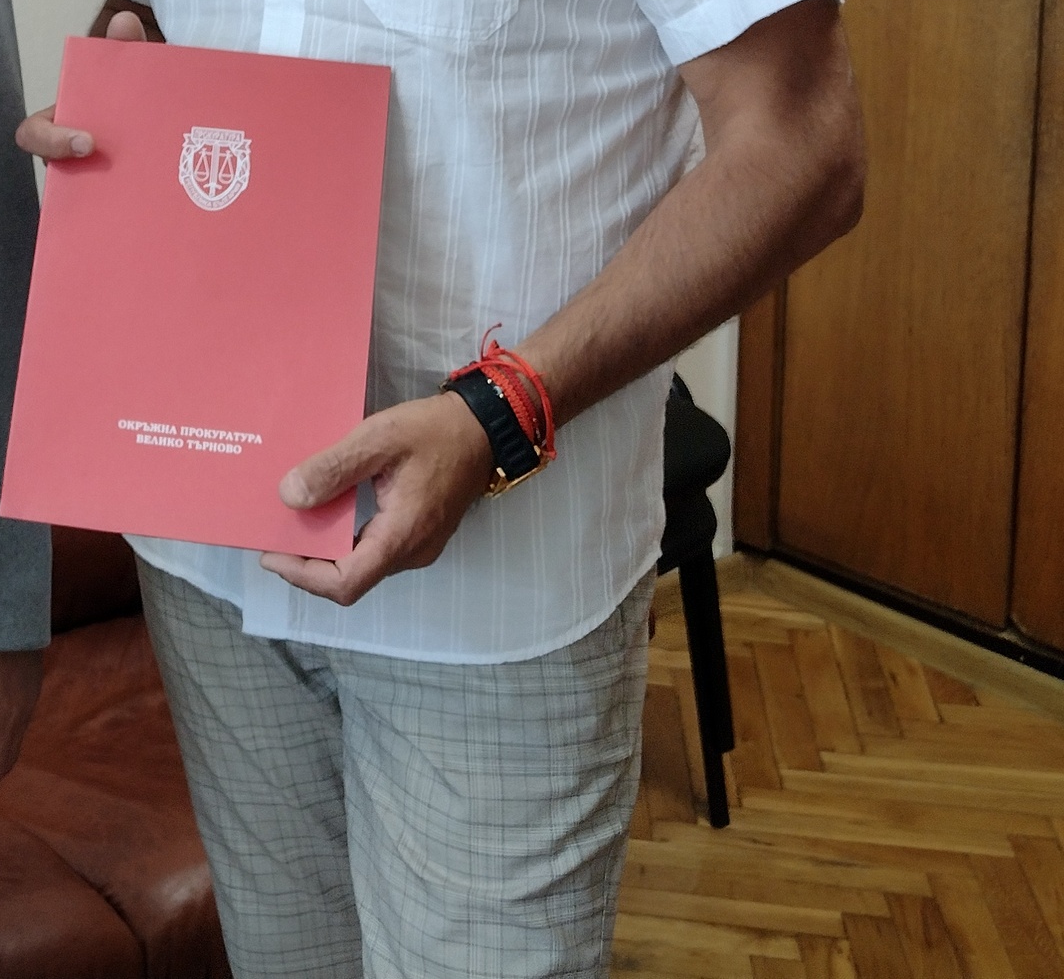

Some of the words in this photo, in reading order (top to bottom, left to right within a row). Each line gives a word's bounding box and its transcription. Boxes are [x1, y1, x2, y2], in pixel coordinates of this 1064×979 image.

[118, 419, 177, 435] ОКРЪЖНА
[180, 426, 263, 444] ПРОКУРАТУРА
[136, 434, 184, 448] ВЕЛИКО
[187, 439, 242, 455] ТЪРНОВО
